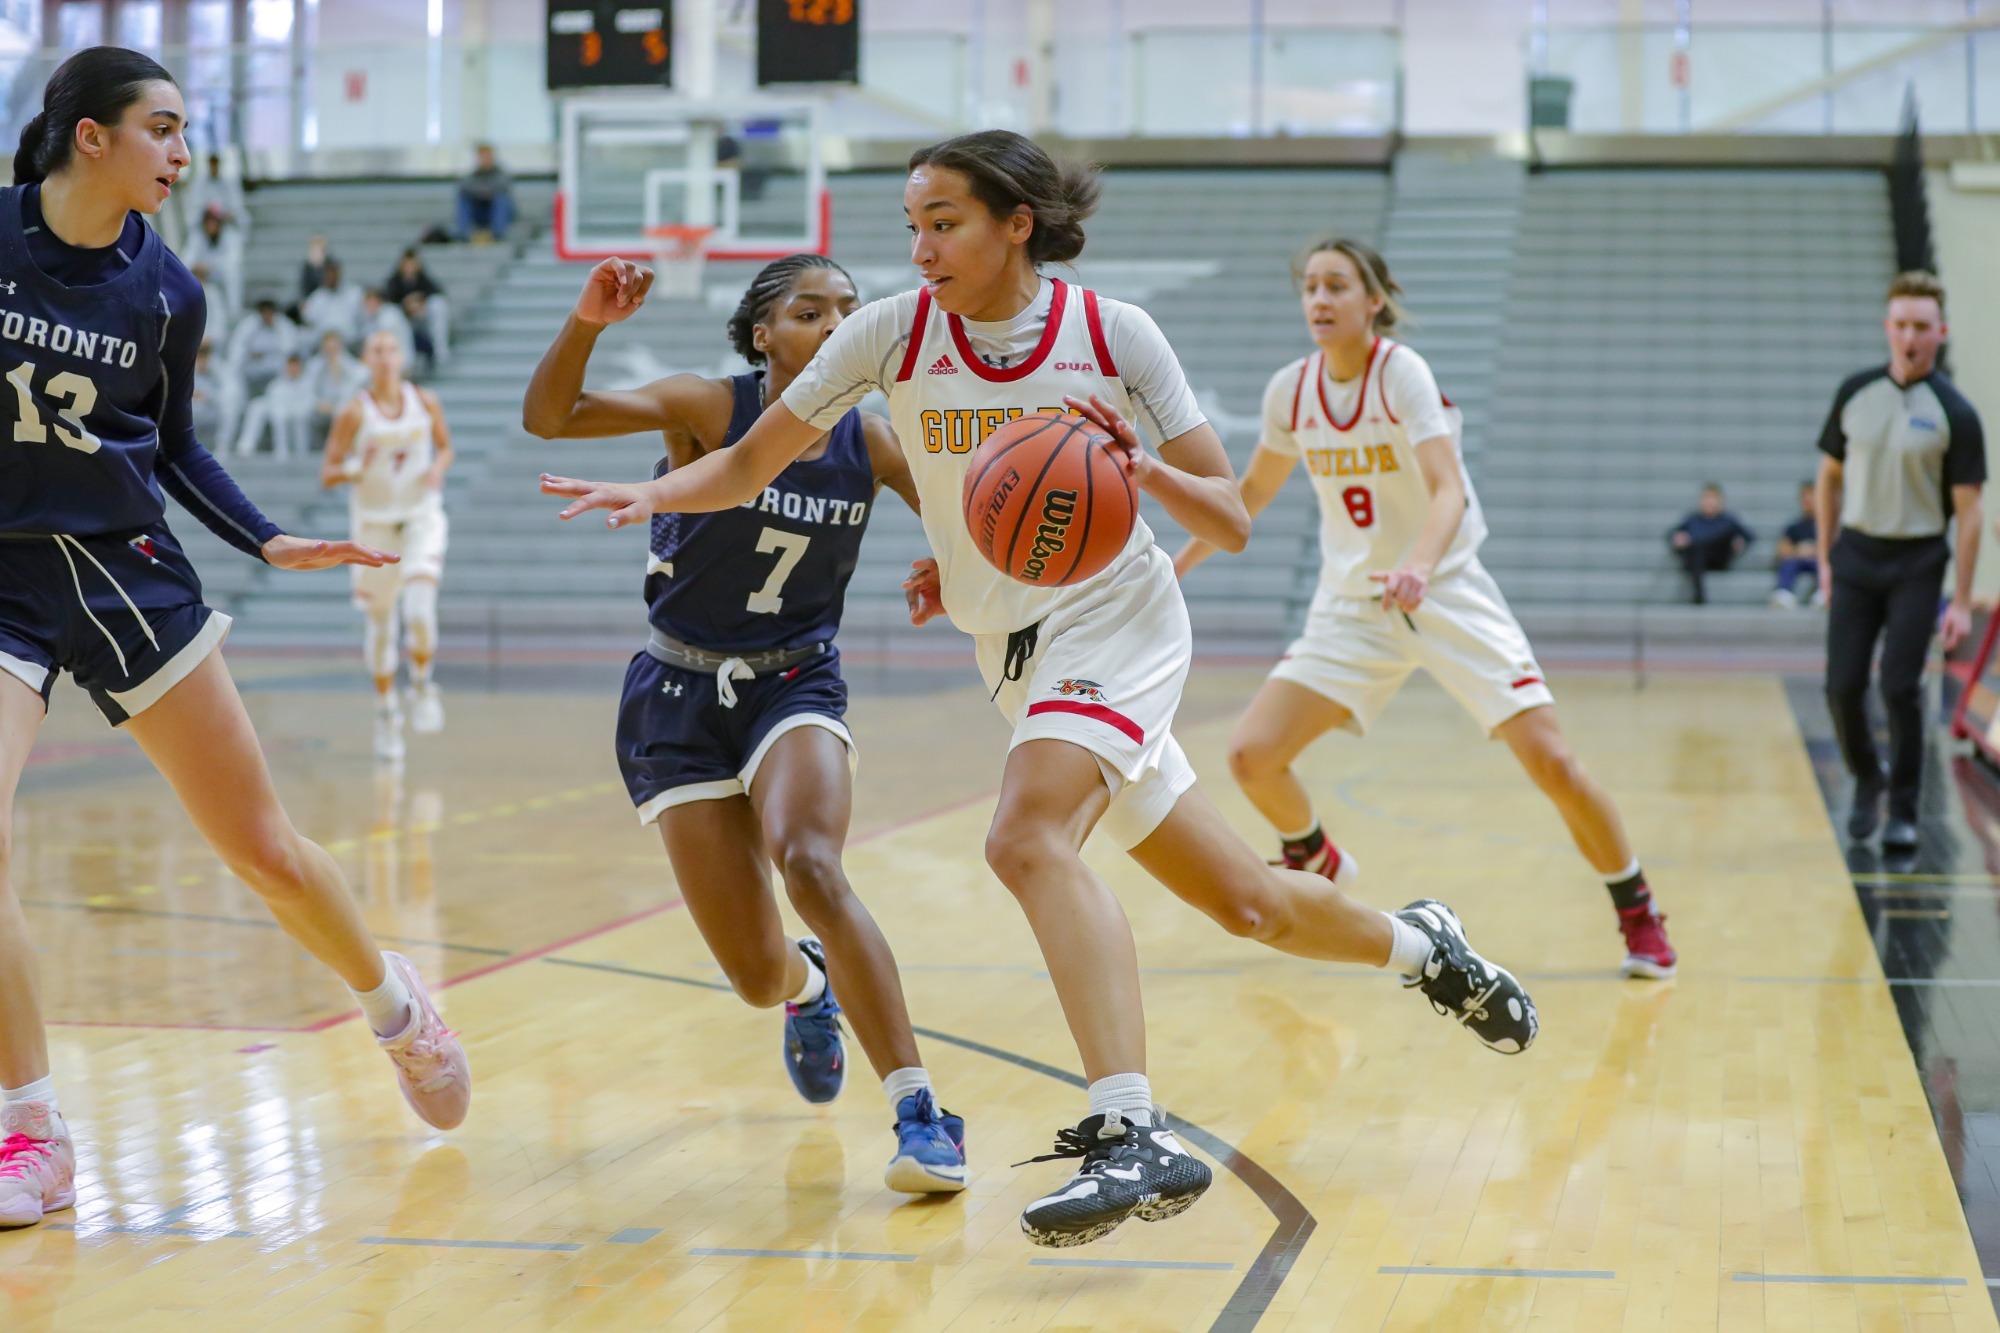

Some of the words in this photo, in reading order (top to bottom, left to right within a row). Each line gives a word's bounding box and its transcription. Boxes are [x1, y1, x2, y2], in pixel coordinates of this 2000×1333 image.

[0, 309, 137, 369] ORONTO
[928, 367, 959, 375] adidas
[1054, 362, 1094, 371] OUA
[6, 361, 101, 455] 13
[920, 407, 1085, 454] GUE
[739, 486, 866, 526] RONTO
[1342, 485, 1374, 528] 8
[1020, 488, 1079, 582] Wilson
[746, 526, 811, 615] 7
